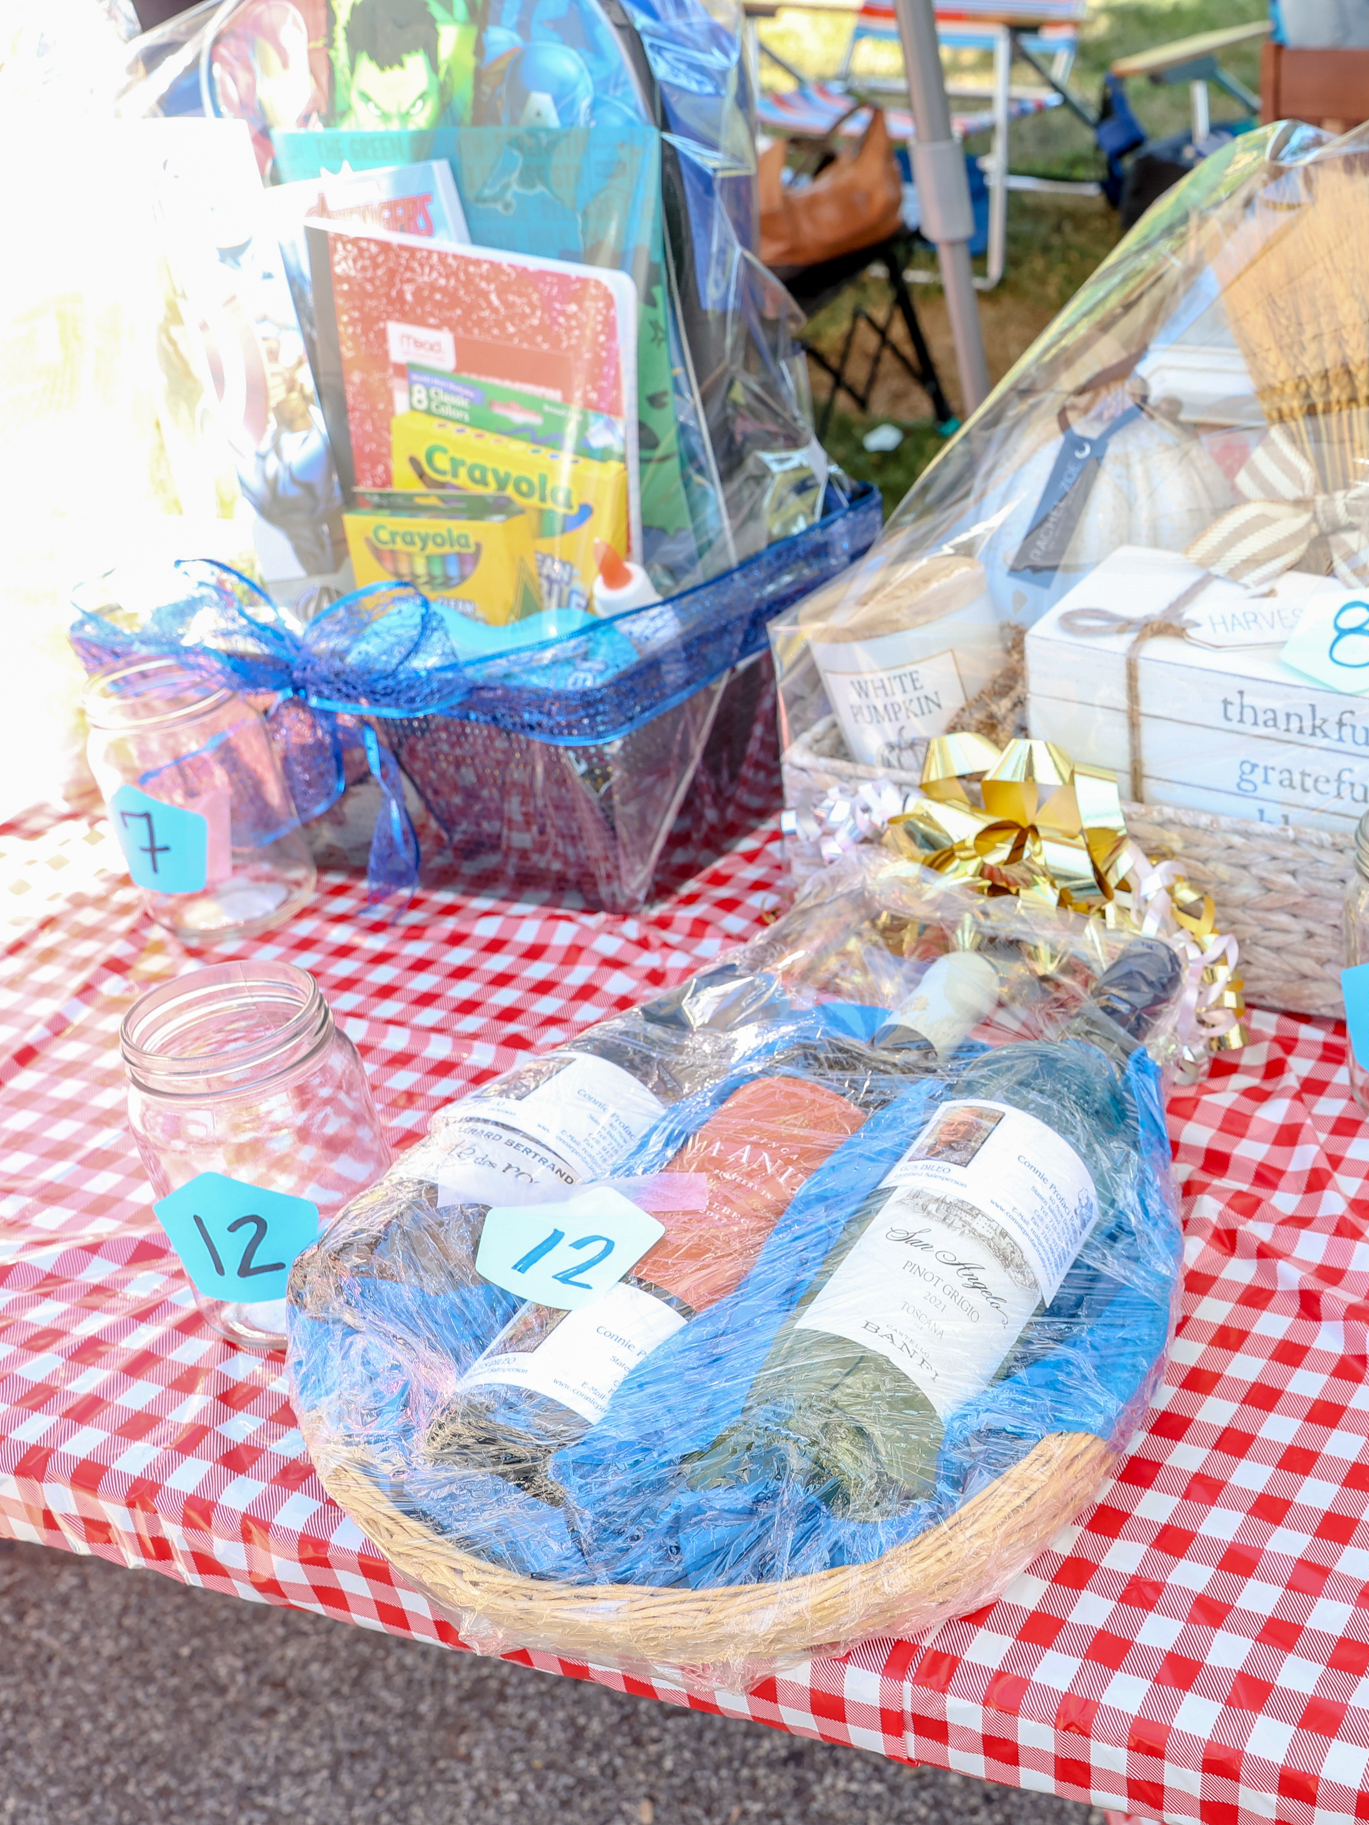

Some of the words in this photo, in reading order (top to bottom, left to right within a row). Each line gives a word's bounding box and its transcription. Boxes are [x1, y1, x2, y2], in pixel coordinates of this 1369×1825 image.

[411, 383, 428, 411] 8
[430, 387, 471, 410] Classic
[430, 401, 471, 423] Colors
[425, 444, 574, 510] Crayola
[373, 524, 472, 551] Crayola
[1208, 608, 1304, 634] HARVES
[850, 670, 923, 700] WHITE
[849, 692, 942, 725] PUMPKIN
[120, 811, 172, 874] 7
[611, 1113, 636, 1141] Profac
[504, 1138, 575, 1185] BERTRAND
[924, 1172, 967, 1188] Salesperson
[1017, 1155, 1050, 1184] Connie
[1049, 1184, 1072, 1214] Profaci
[1031, 1186, 1048, 1205] Staten
[704, 1200, 749, 1228] LBEC
[193, 1214, 286, 1278] 12
[511, 1228, 616, 1290] 12
[885, 1227, 934, 1253] San
[935, 1250, 1009, 1326] Angelo
[902, 1260, 944, 1288] PINOT
[942, 1283, 980, 1323] GRIGIO
[923, 1291, 947, 1313] 2021
[900, 1300, 945, 1340] TOSCANA
[596, 1325, 636, 1351] Connie
[861, 1320, 941, 1384] BANFI
[886, 1324, 930, 1359] CASTELLO
[581, 1381, 607, 1401] E-Mail:
